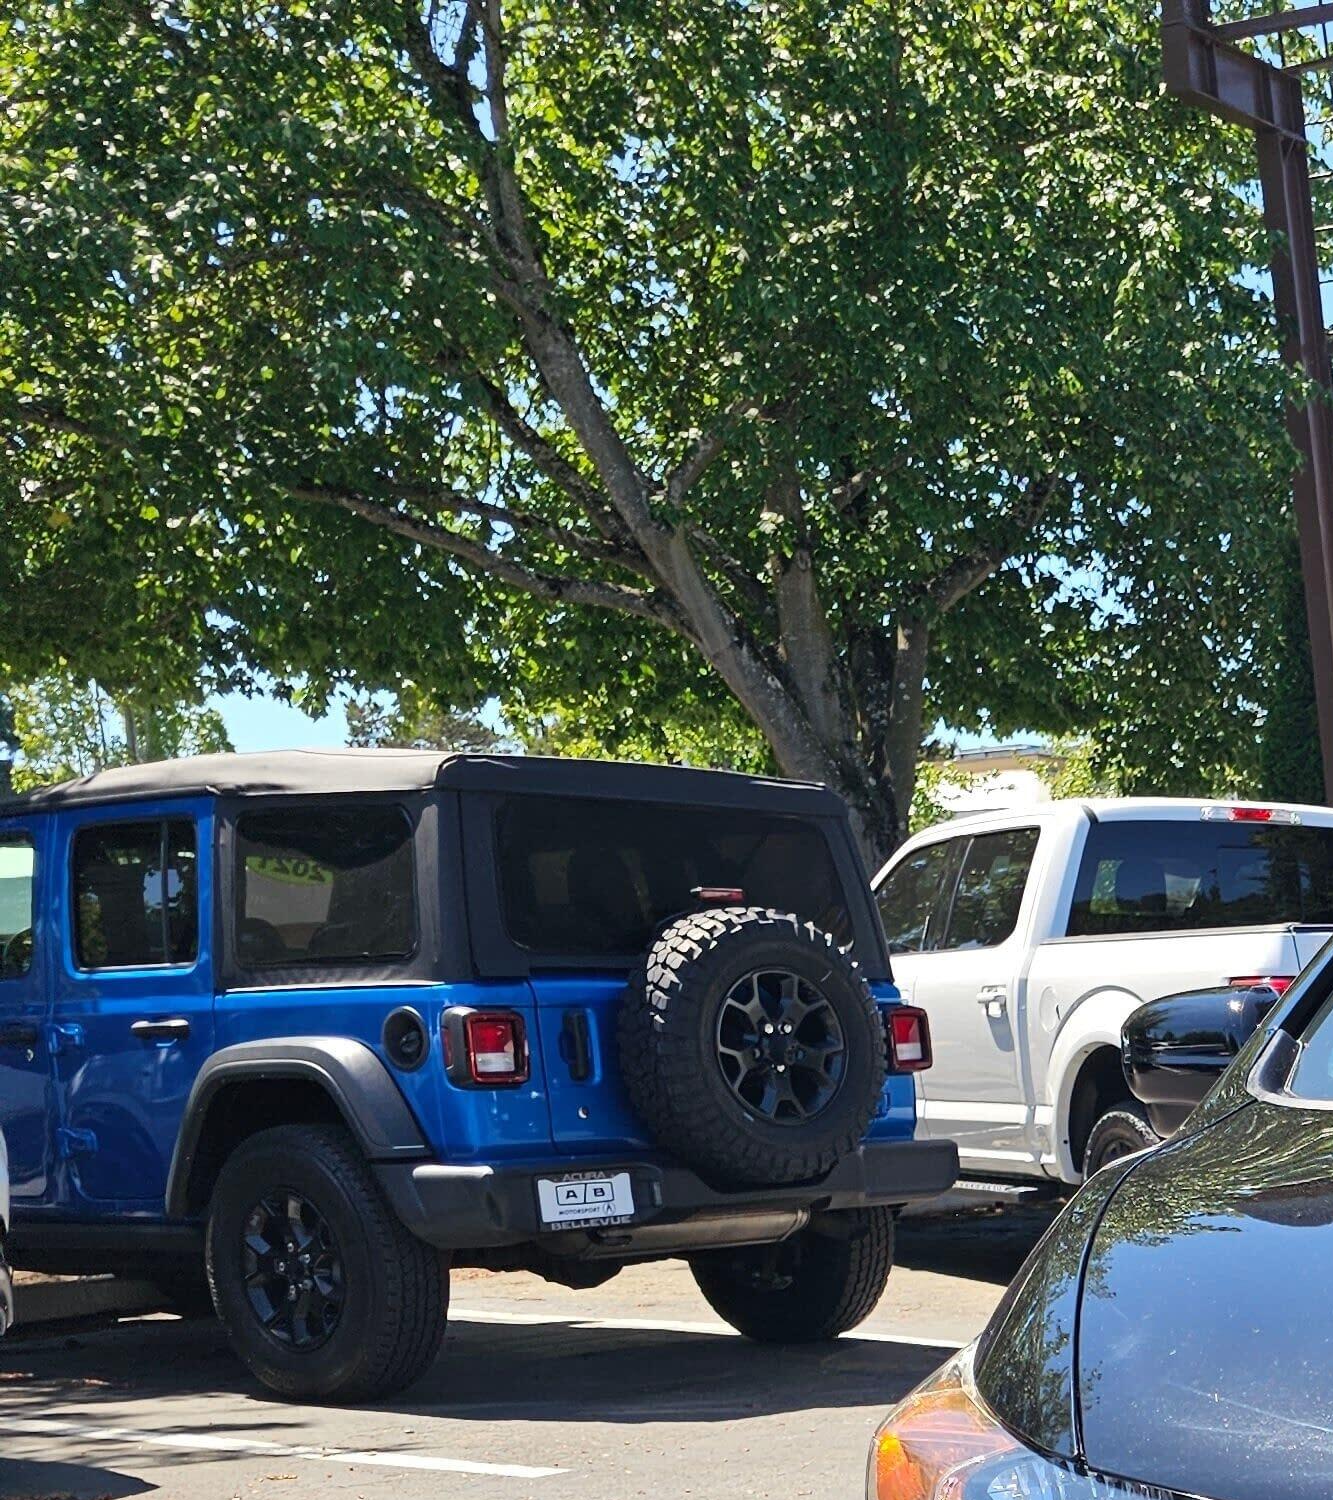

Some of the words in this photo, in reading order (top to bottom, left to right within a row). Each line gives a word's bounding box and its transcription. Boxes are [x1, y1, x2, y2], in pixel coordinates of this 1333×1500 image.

[562, 1170, 606, 1182] ACURA
[565, 1189, 578, 1199] A
[593, 1187, 605, 1197] B
[551, 1215, 632, 1231] BELLEVUE
